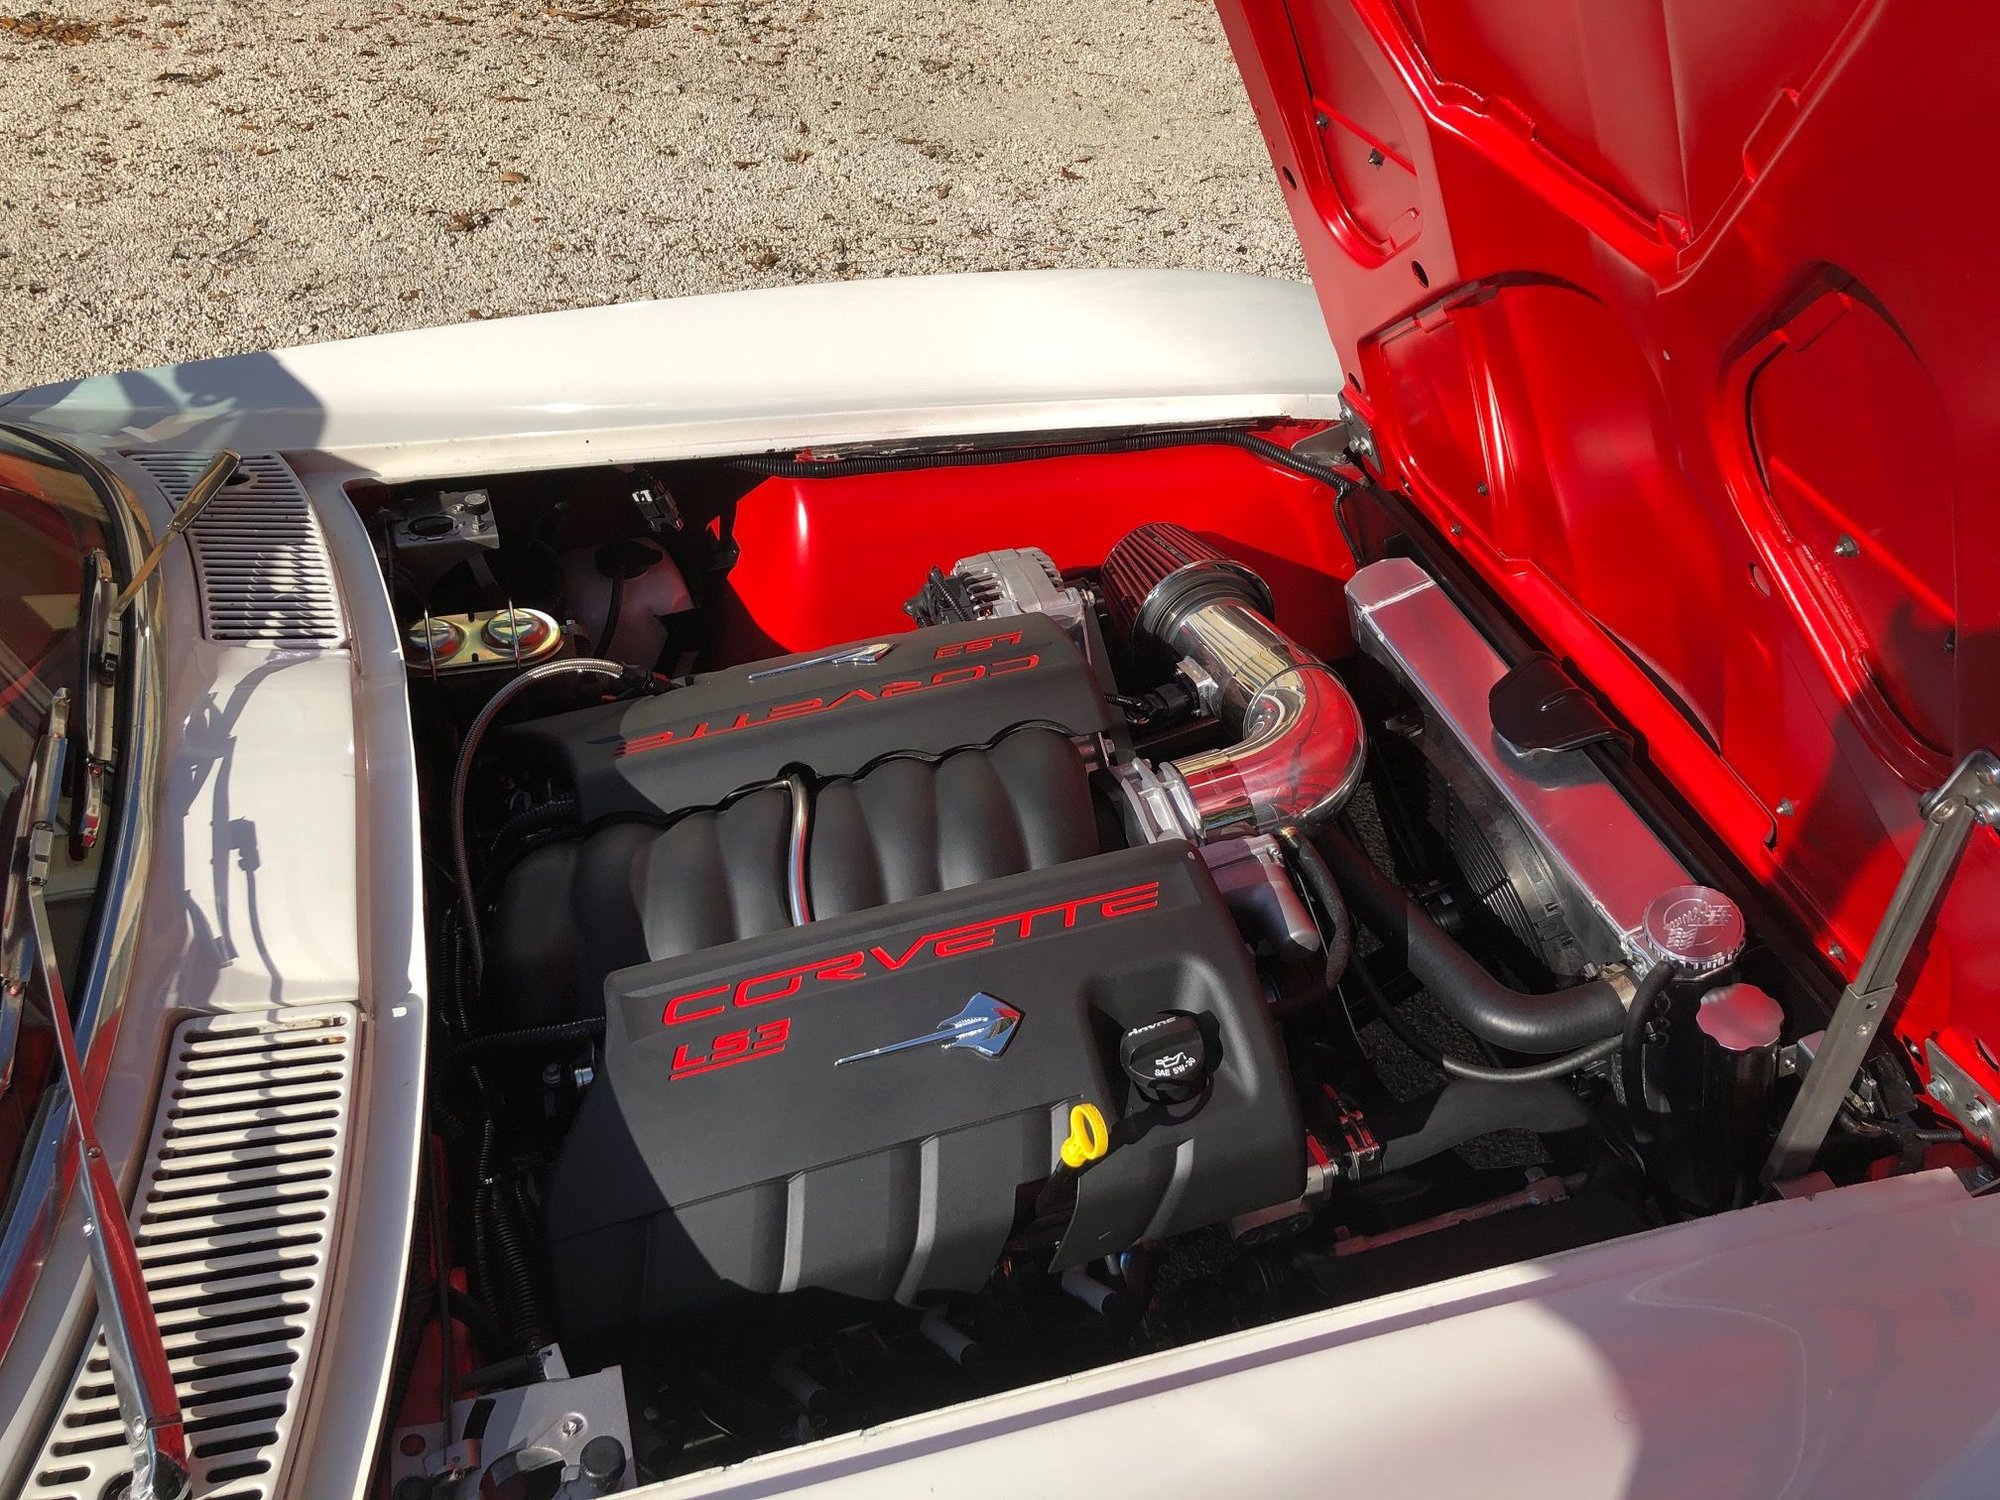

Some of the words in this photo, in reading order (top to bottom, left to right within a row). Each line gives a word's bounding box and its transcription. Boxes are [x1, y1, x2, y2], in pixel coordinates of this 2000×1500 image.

[612, 655, 1039, 757] CORVETTE
[662, 881, 1159, 1026] CORVETTE
[671, 1017, 791, 1071] LS3
[1154, 1069, 1171, 1077] SAE
[1173, 1057, 1196, 1075] 5W-30
